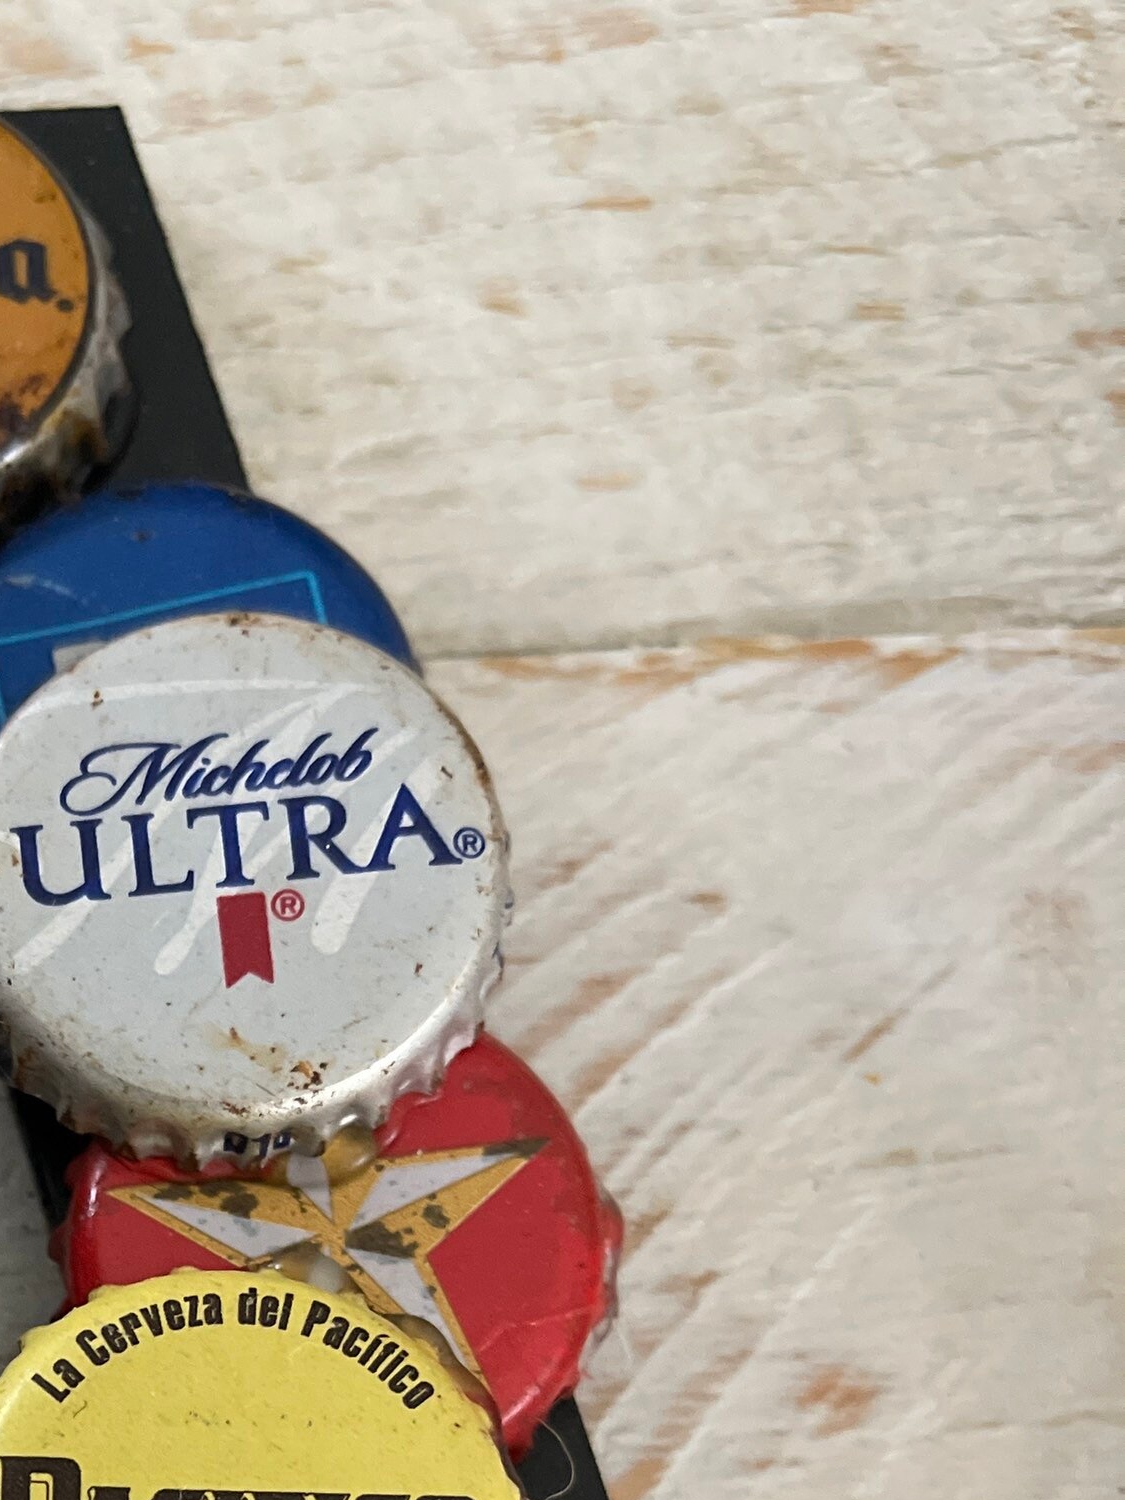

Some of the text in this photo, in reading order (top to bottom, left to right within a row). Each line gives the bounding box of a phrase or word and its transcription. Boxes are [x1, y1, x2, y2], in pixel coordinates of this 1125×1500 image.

[60, 727, 378, 815] Michelob
[11, 783, 464, 906] ULTRA
[31, 1287, 436, 1410] La Cerveza del Pacífico
